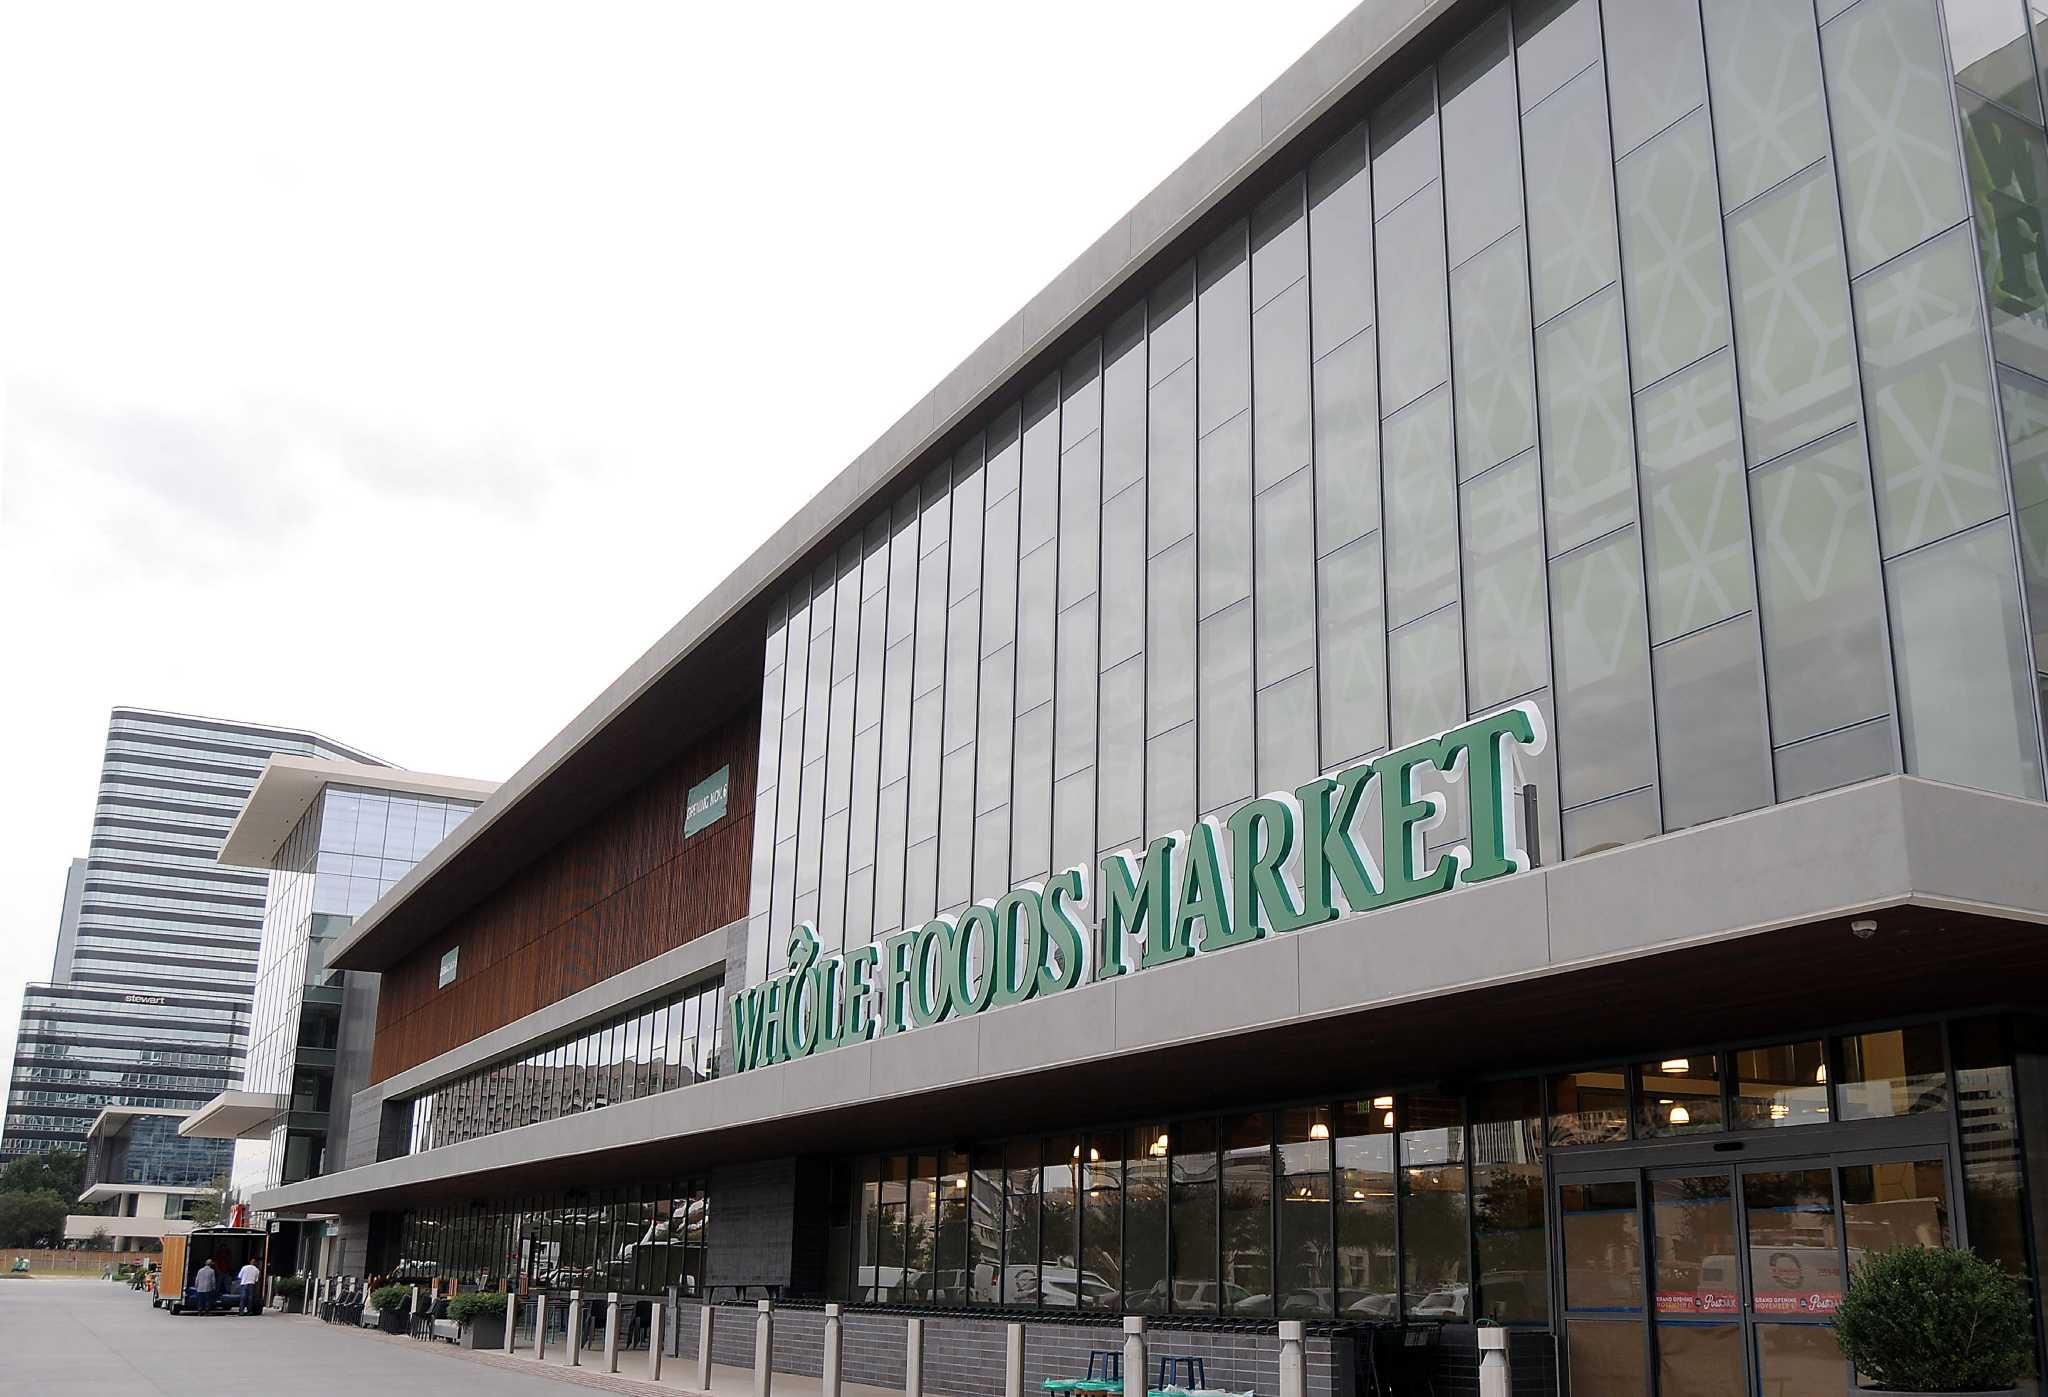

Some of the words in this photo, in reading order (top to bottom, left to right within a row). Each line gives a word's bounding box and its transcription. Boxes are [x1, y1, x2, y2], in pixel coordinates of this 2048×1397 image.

[729, 922, 880, 1073] WHOLE
[883, 866, 1088, 1035] FOODS
[1099, 702, 1545, 977] MARKET
[125, 995, 166, 1004] stewart
